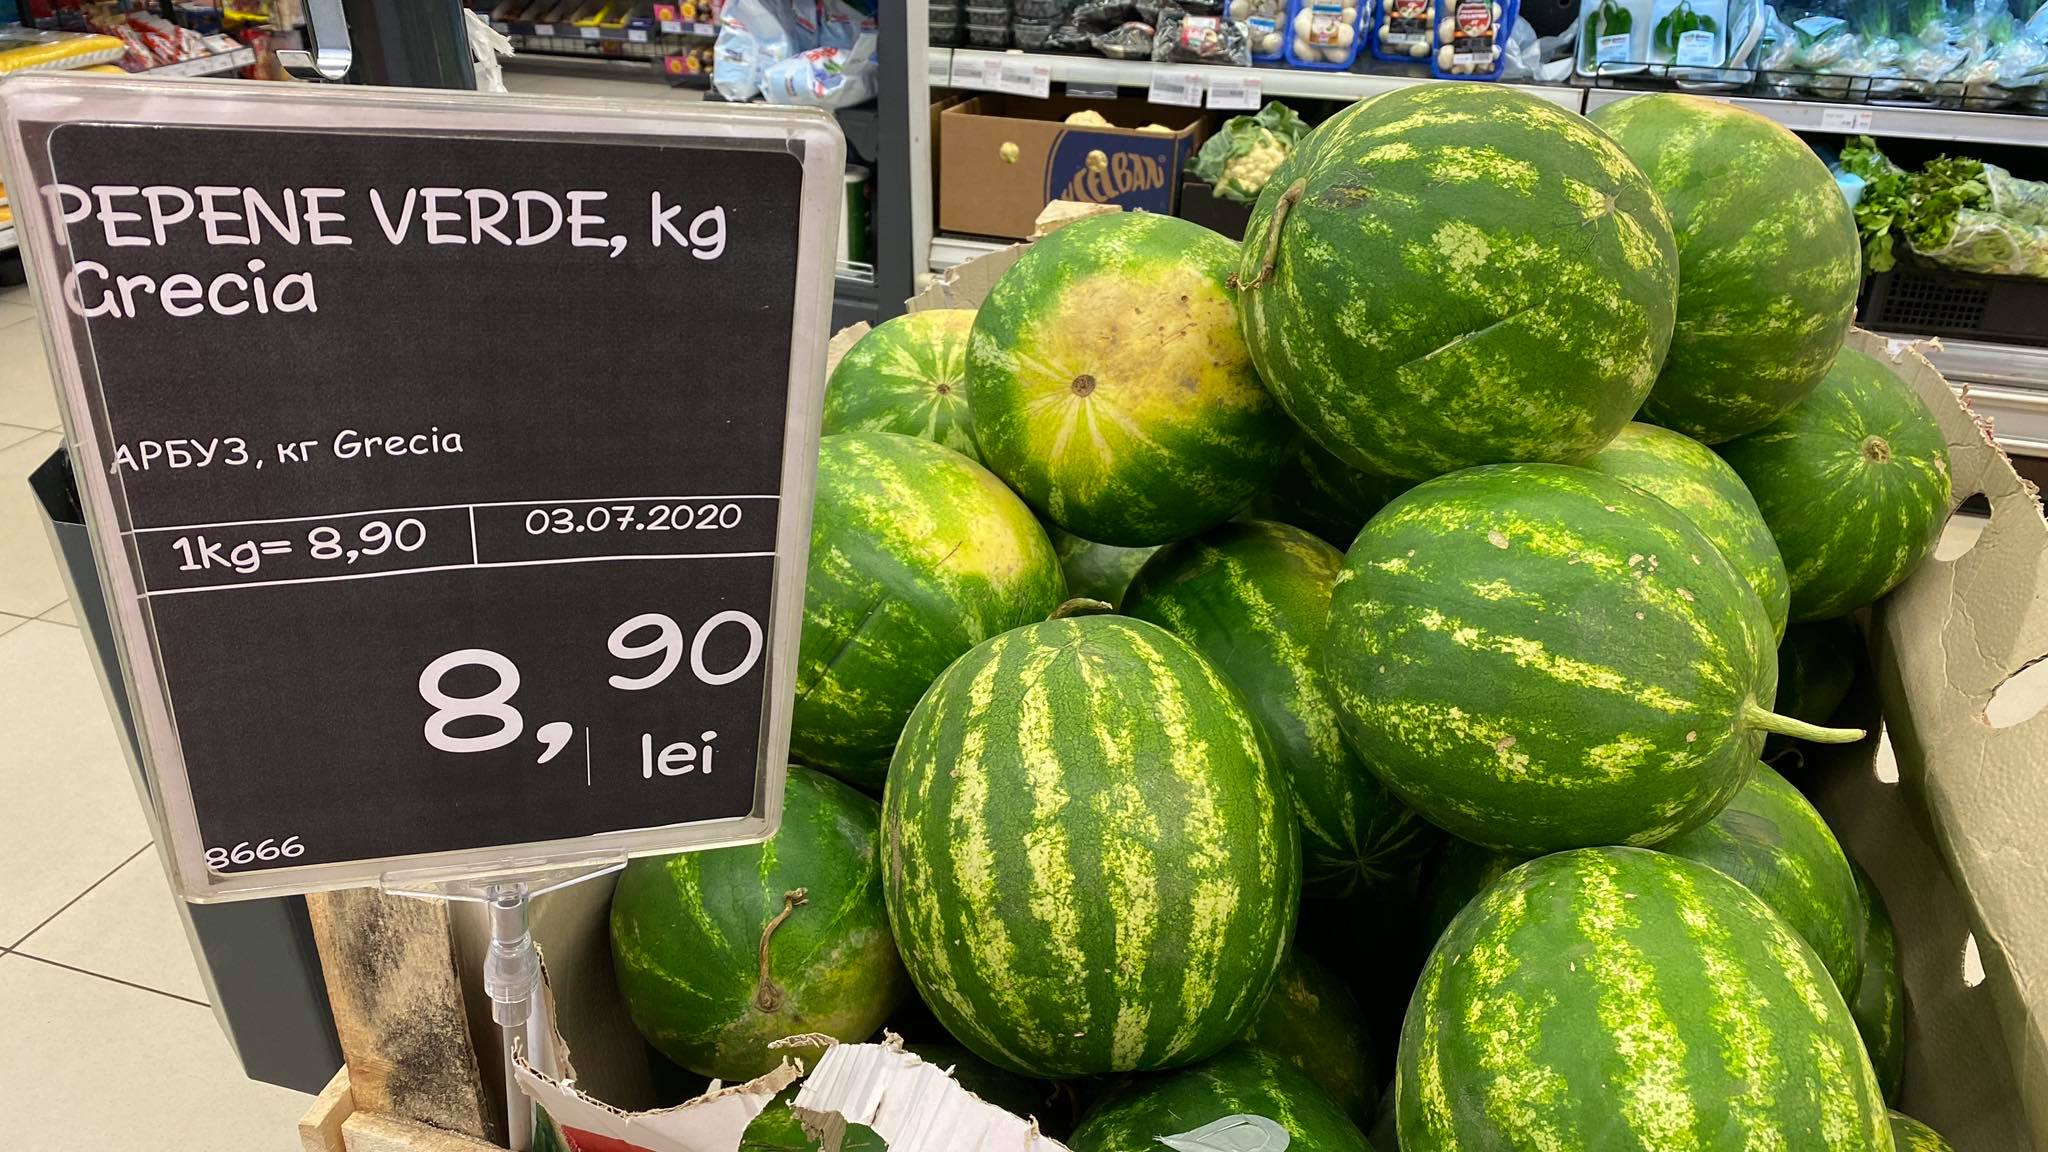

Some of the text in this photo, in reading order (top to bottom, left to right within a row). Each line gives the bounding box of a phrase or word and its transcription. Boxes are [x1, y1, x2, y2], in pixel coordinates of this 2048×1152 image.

[40, 184, 727, 261] PEPENE VERDE, kg
[63, 258, 318, 318] Grecia
[110, 426, 464, 475] АРБУЗ, кг Grecia
[525, 503, 743, 535] 03.07.2020
[171, 518, 427, 575] 1kg= 8,90
[607, 610, 764, 691] 90
[641, 730, 718, 779] lei
[204, 835, 305, 870] 8666
